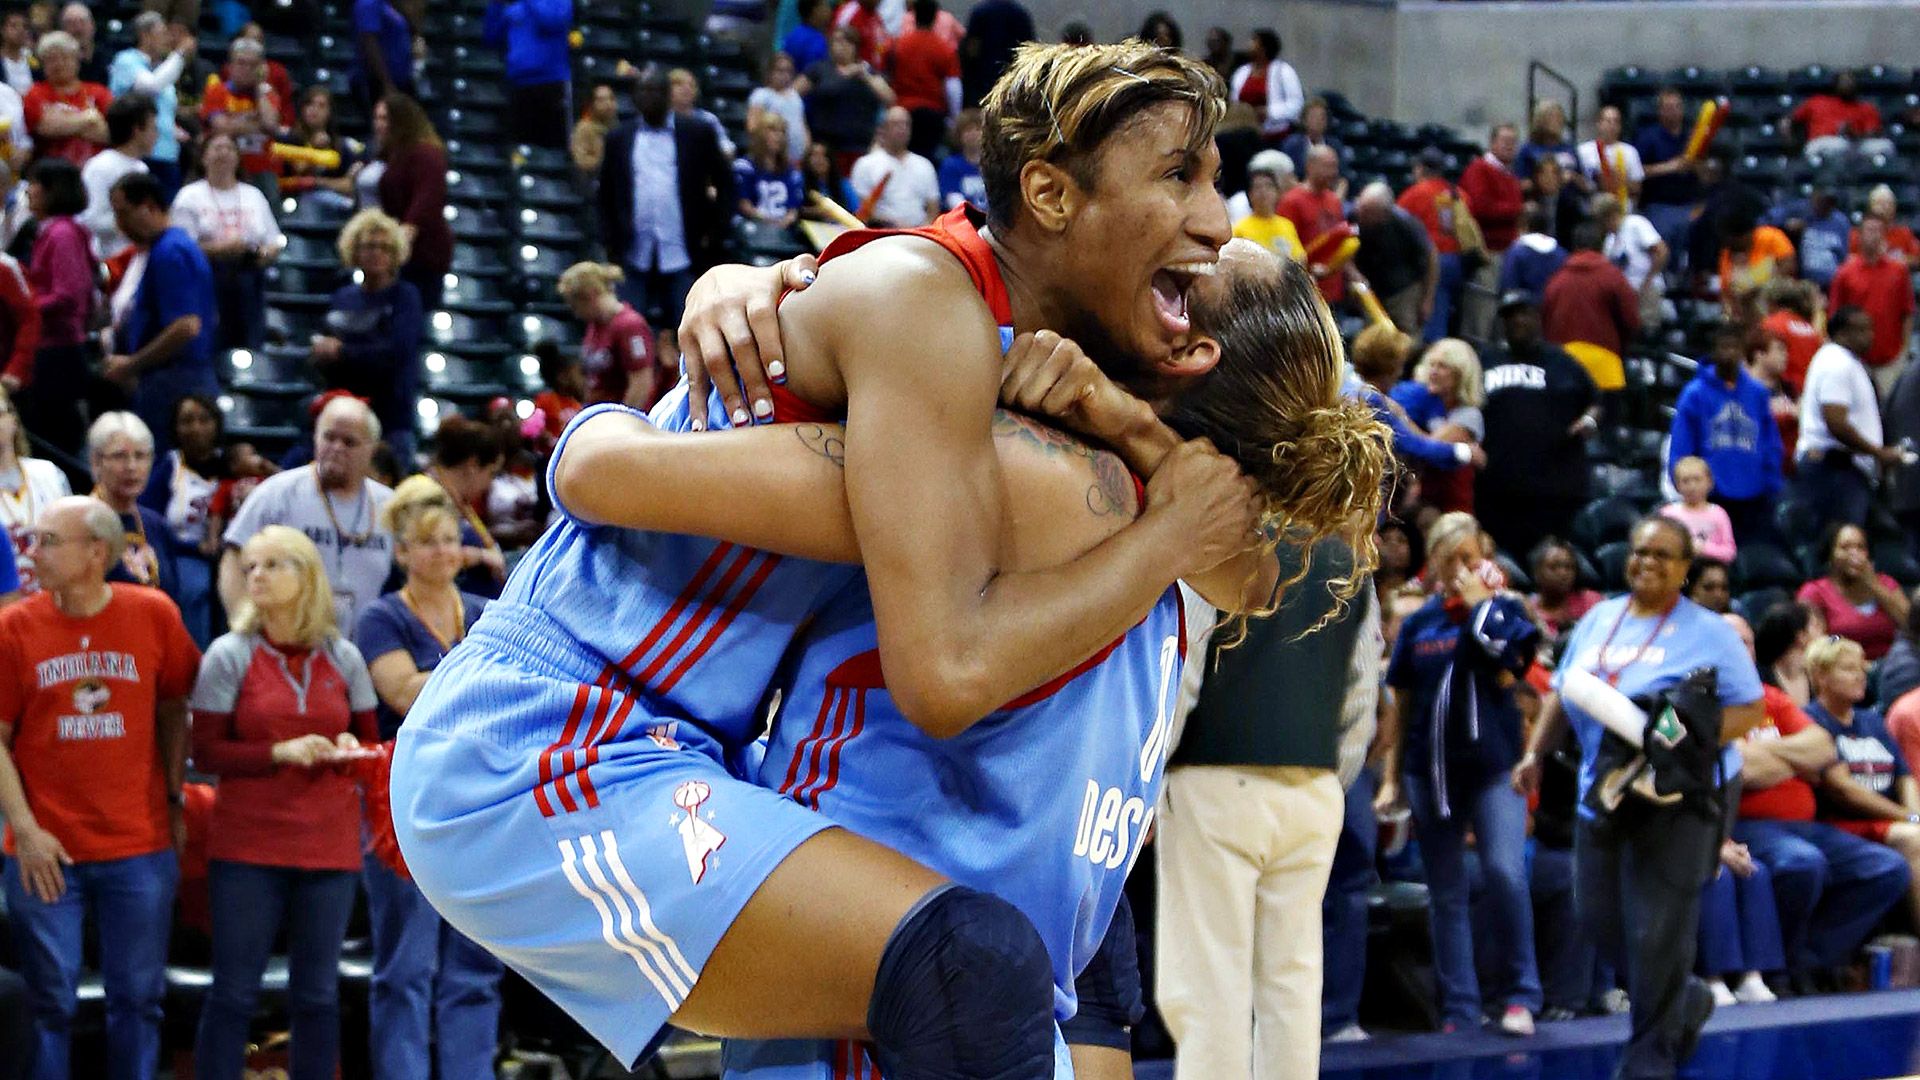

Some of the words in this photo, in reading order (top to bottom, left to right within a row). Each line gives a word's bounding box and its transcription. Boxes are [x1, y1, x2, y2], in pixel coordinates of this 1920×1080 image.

[758, 180, 788, 217] 12
[1484, 364, 1546, 391] NIKE
[36, 651, 139, 688] INDIANA
[57, 712, 126, 739] FEVER
[1141, 635, 1178, 783] 1
